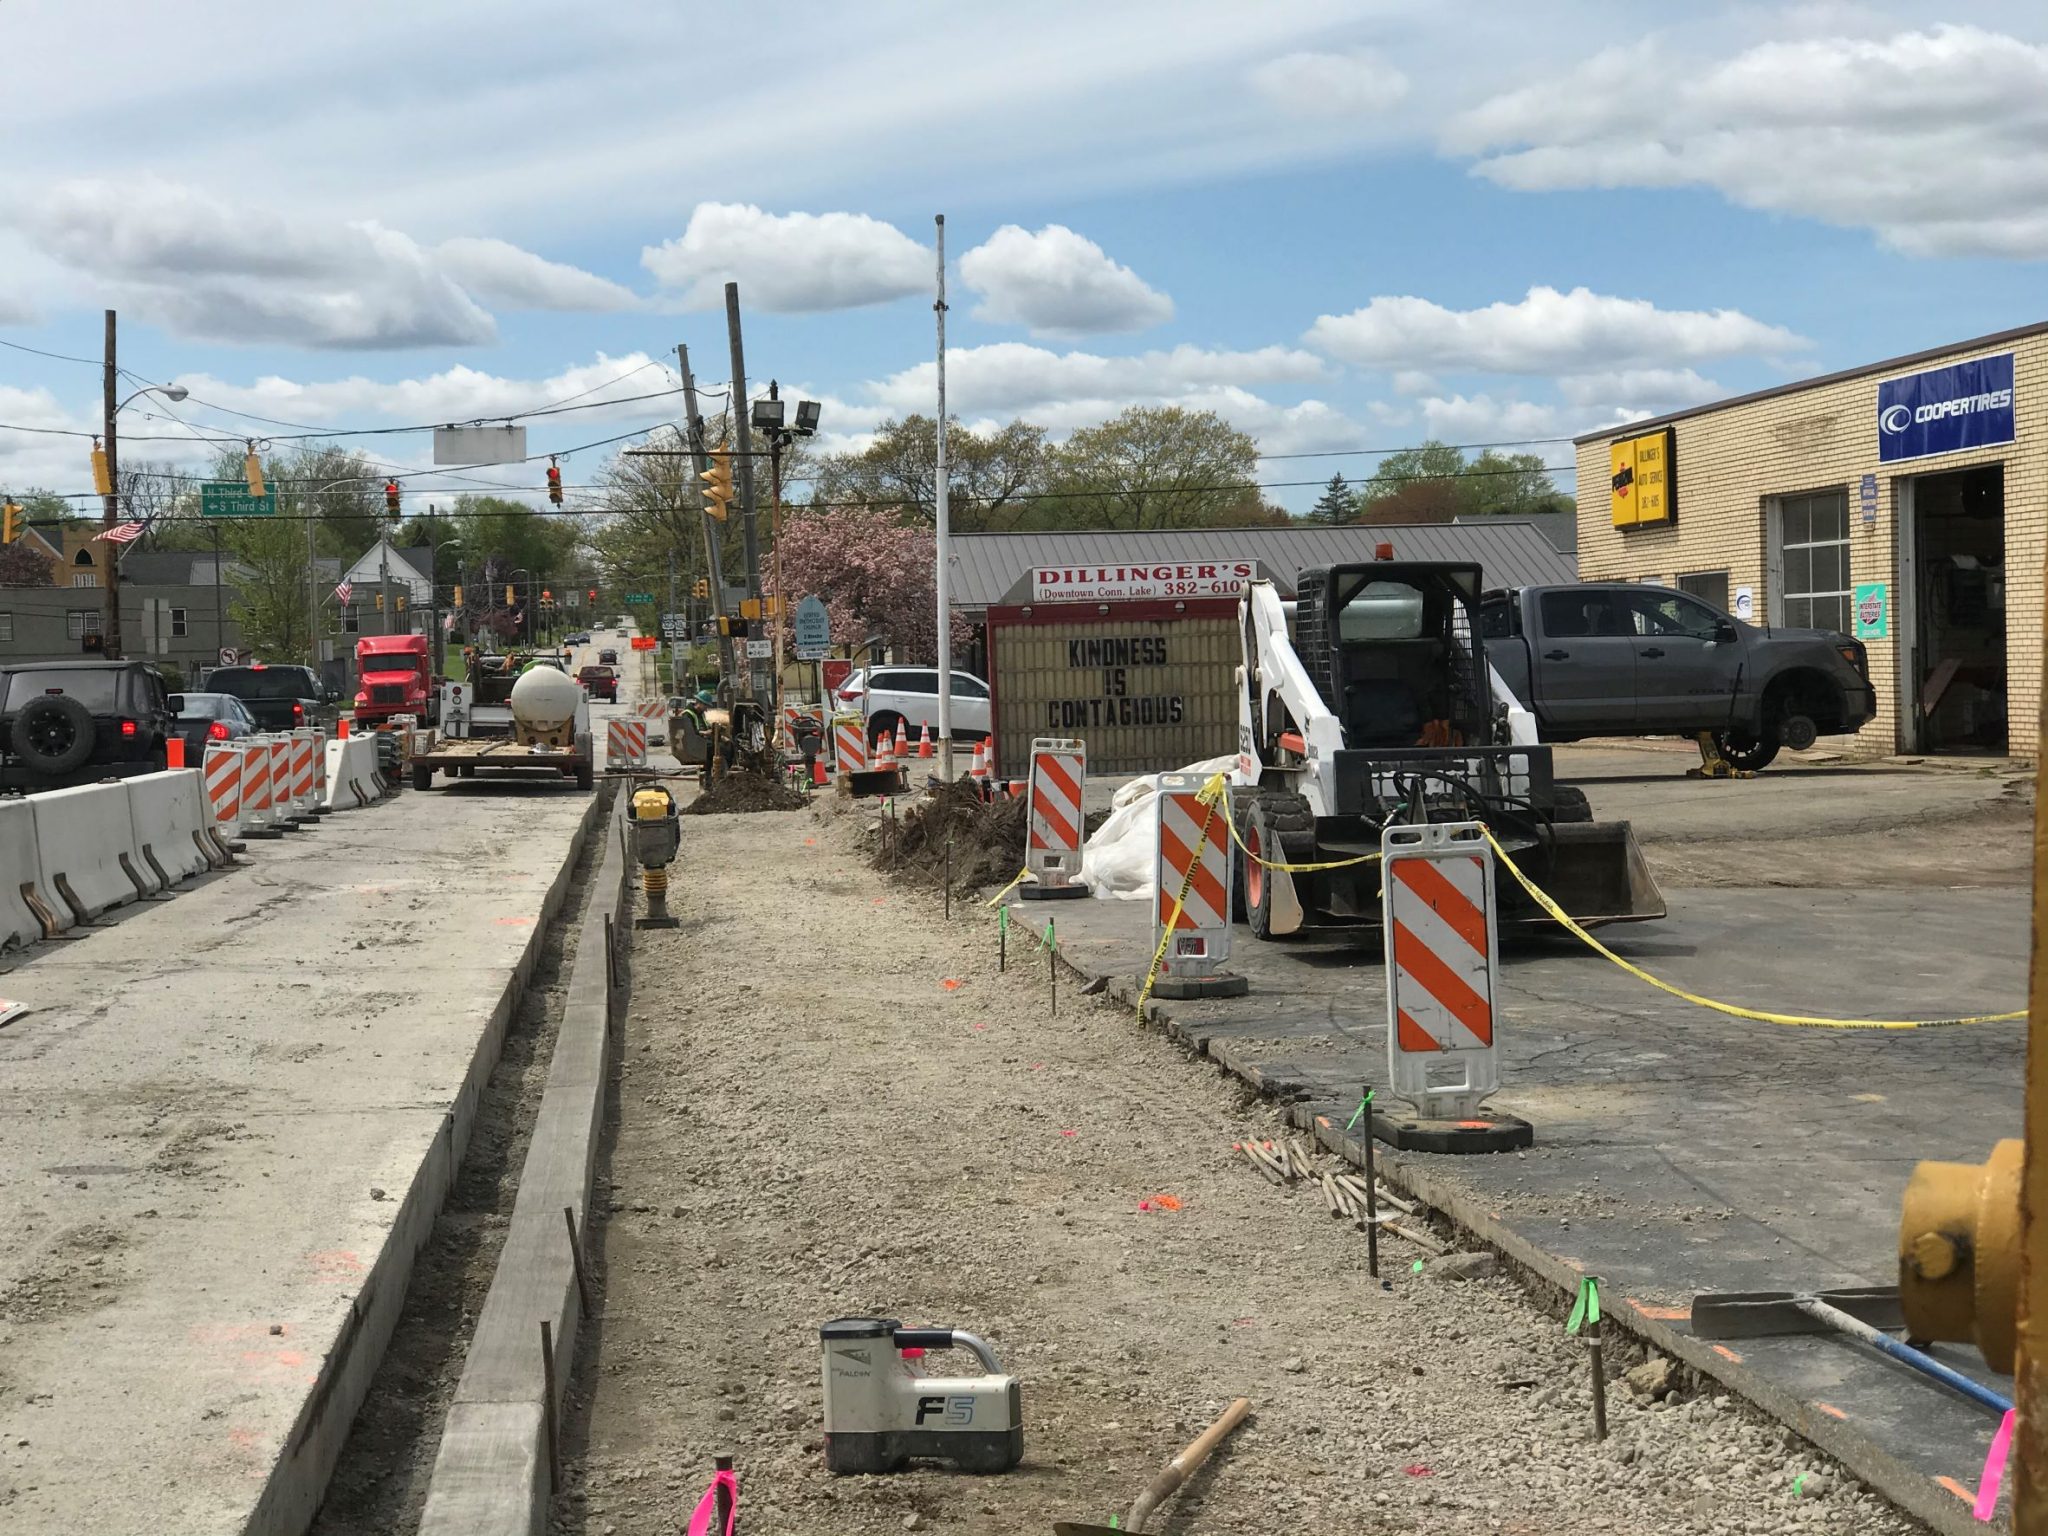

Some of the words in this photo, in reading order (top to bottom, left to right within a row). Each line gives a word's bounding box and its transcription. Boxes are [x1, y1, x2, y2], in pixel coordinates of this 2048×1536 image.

[219, 501, 226, 511] S
[230, 500, 255, 511] Third
[259, 500, 269, 511] St
[1038, 563, 1252, 585] DILLINGER'S
[1039, 587, 1094, 600] (Downtown
[1097, 585, 1127, 598] Conn.
[1129, 584, 1157, 597] Lake)
[1164, 579, 1245, 596] 382-610
[1069, 637, 1167, 668] KINDNESS
[1105, 668, 1126, 696] IS
[1049, 696, 1182, 729] CONTAGIOUS
[914, 1396, 976, 1426] F5
